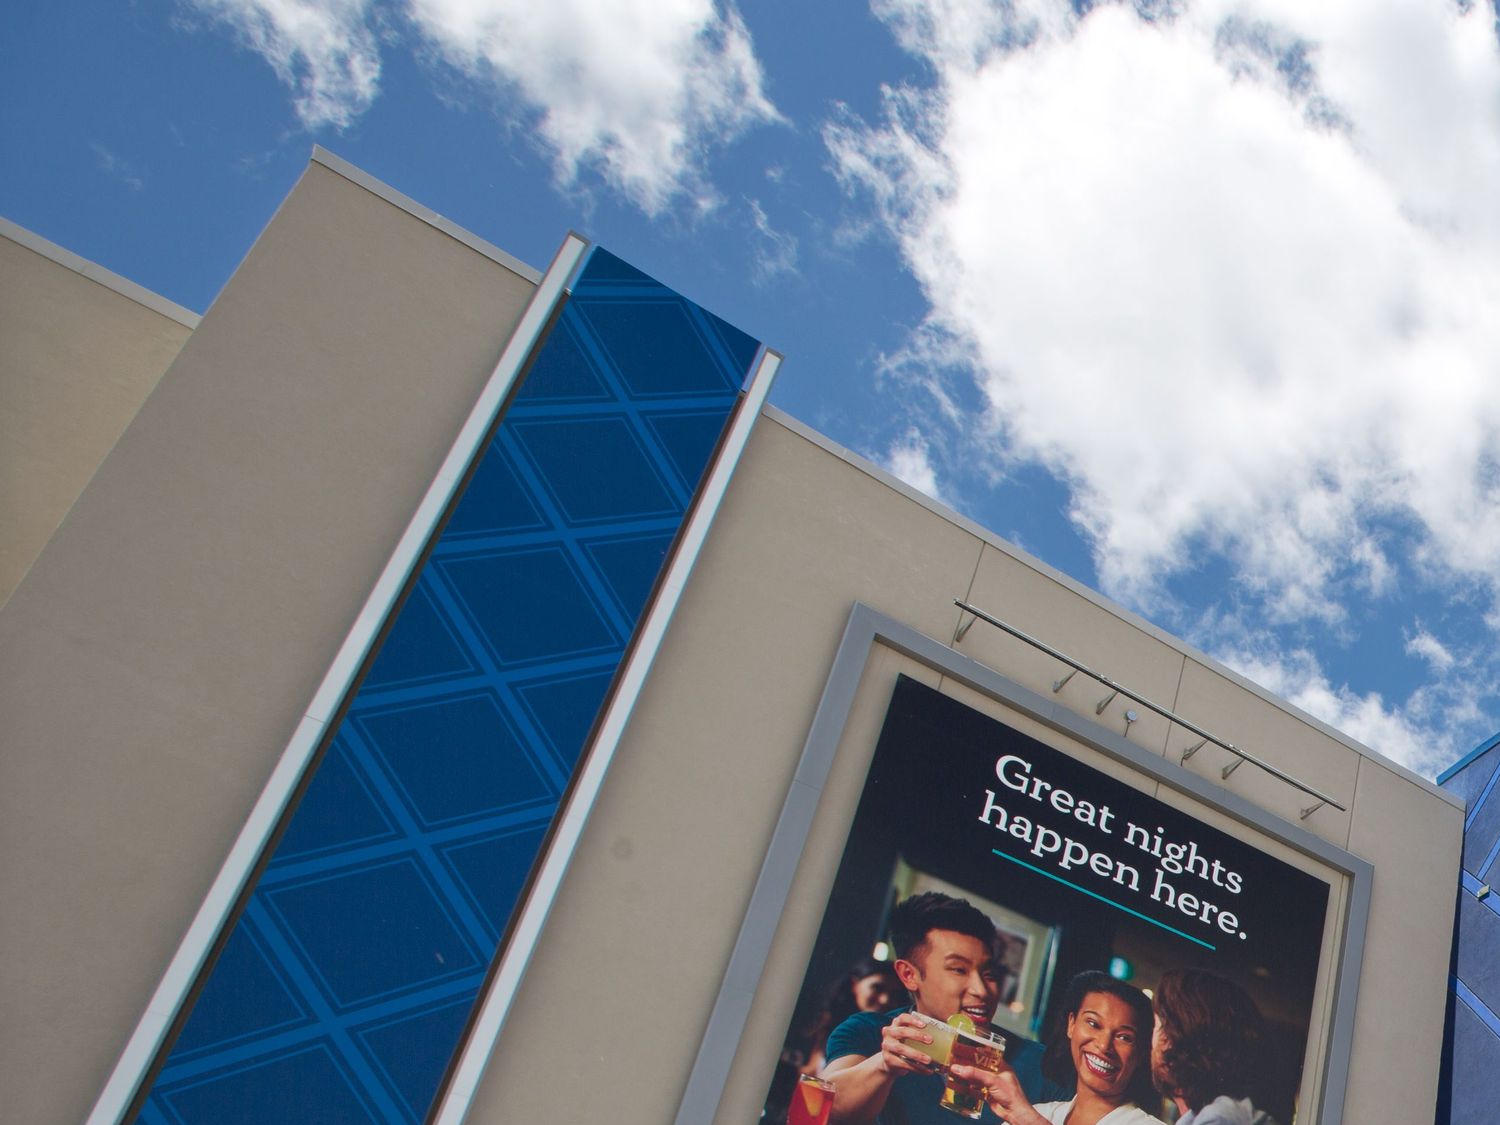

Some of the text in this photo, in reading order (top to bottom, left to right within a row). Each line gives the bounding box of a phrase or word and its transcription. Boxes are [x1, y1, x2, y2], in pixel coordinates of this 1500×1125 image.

[978, 789, 1247, 940] happen here.
[995, 754, 1243, 894] Great nights
